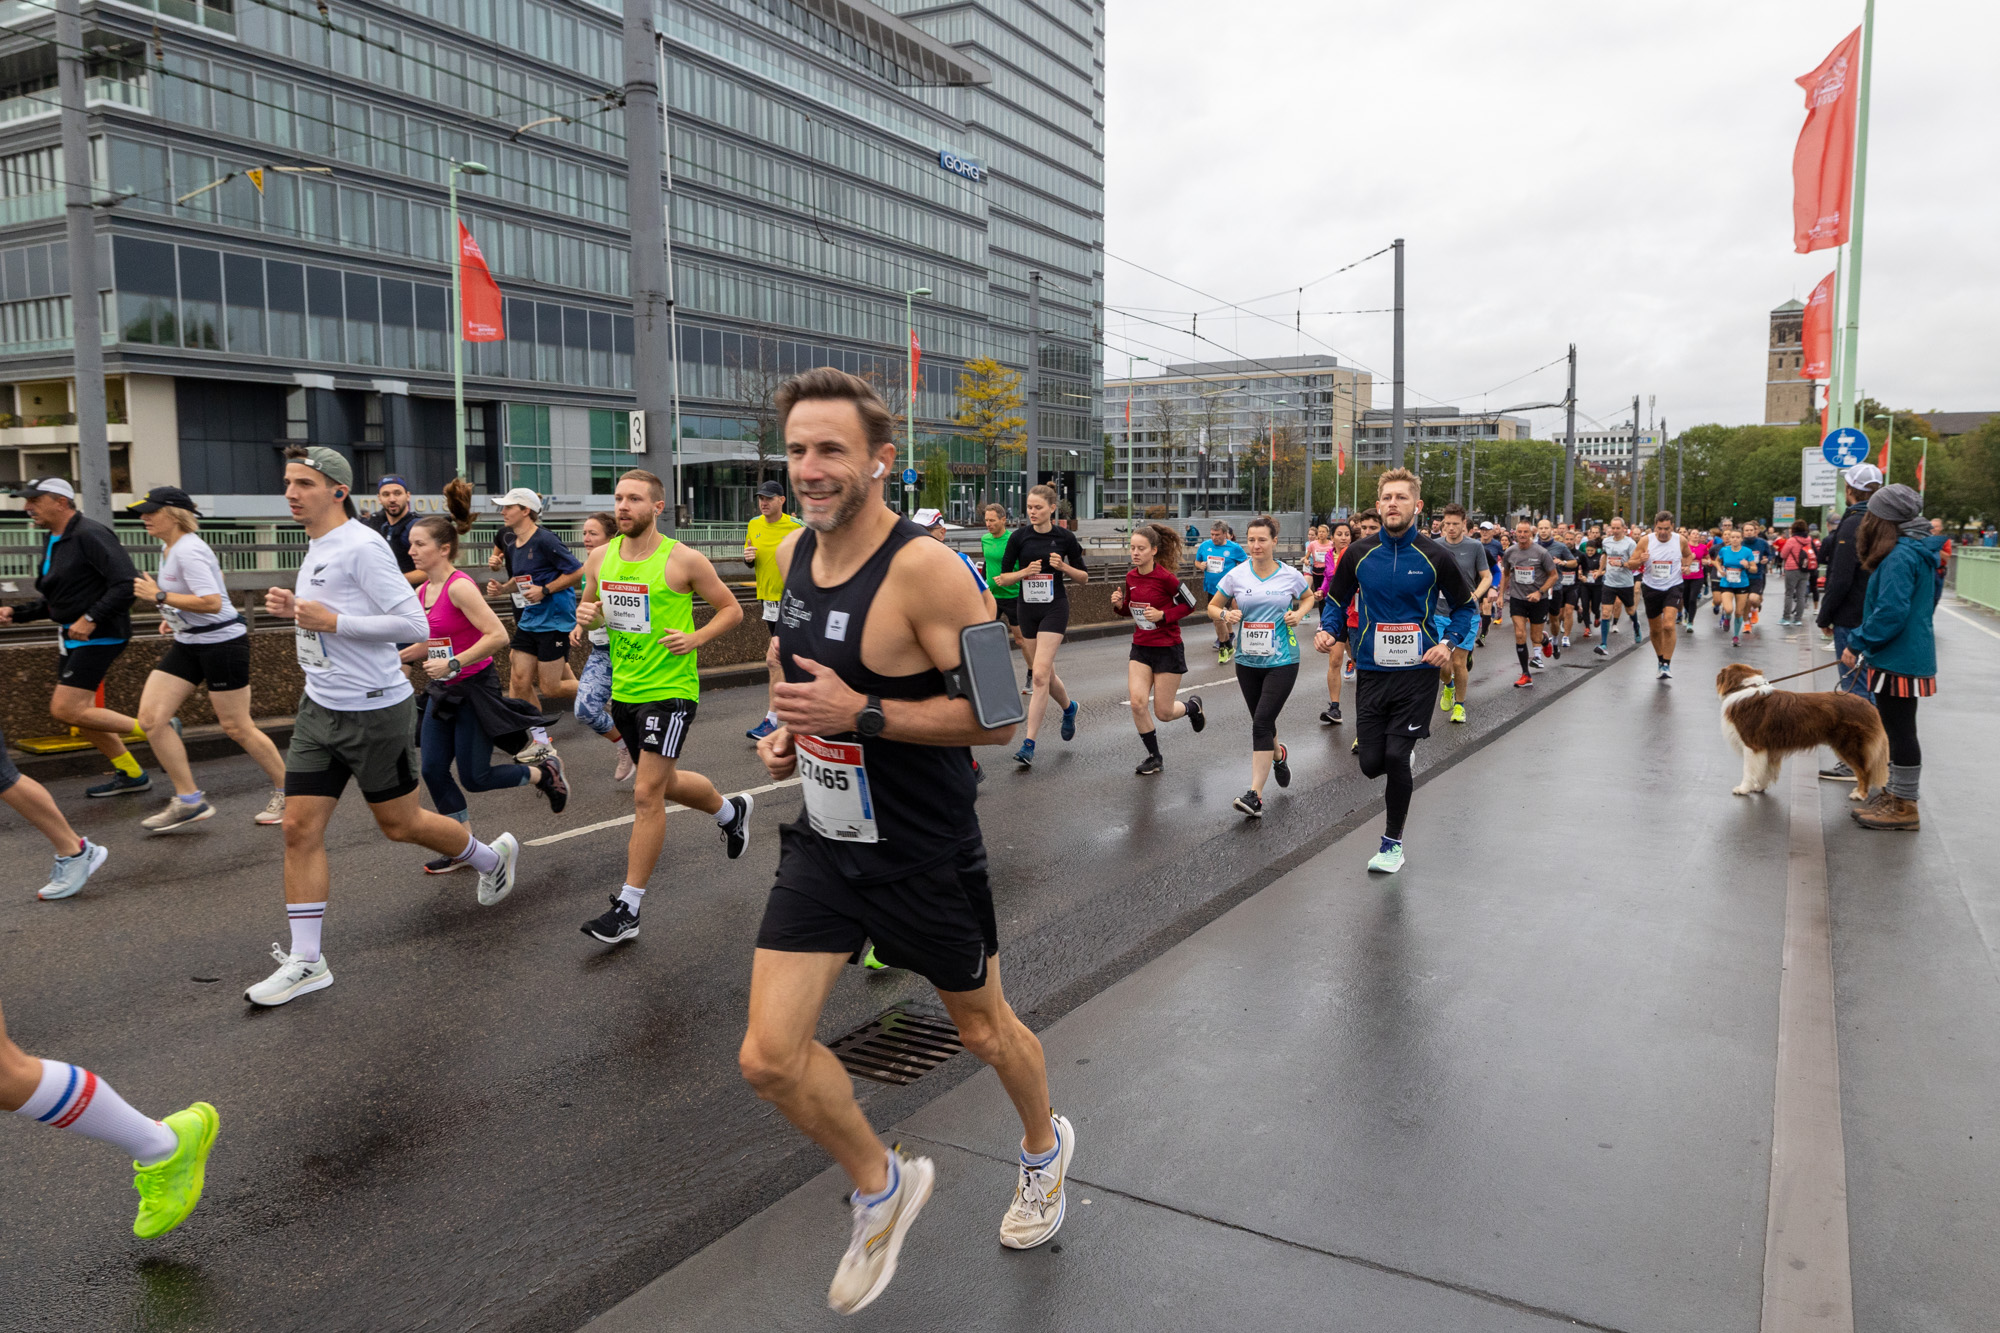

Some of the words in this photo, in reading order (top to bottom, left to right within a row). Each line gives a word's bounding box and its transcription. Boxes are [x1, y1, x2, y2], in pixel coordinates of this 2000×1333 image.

[632, 416, 642, 446] 3
[614, 584, 640, 592] GENERALI
[607, 594, 641, 608] 12055
[613, 610, 635, 618] Steffen
[1246, 630, 1269, 639] 14577
[1382, 634, 1414, 645] 19823
[645, 716, 661, 732] SL
[800, 754, 850, 791] 27465
